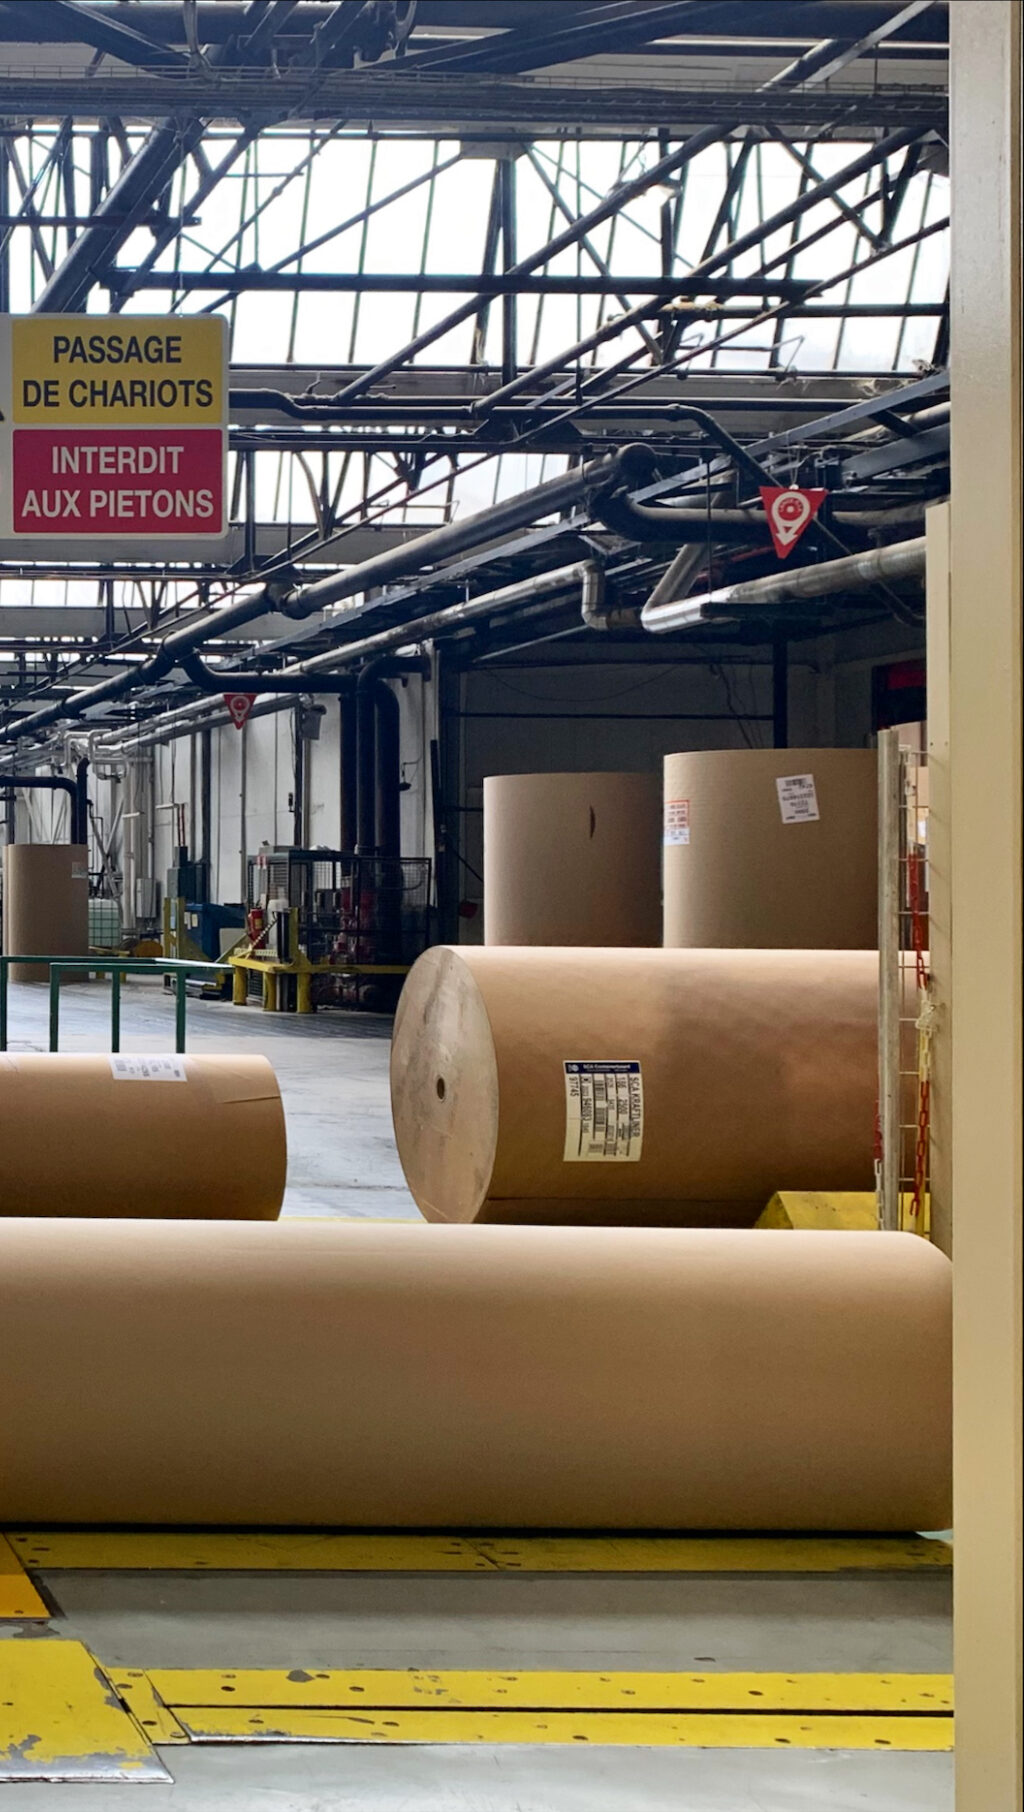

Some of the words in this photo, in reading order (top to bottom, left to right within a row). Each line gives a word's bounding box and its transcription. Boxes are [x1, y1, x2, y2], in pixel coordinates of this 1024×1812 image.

[53, 335, 183, 364] PASSAGE
[23, 379, 61, 408] DE
[68, 379, 214, 408] CHARIOTS
[52, 446, 185, 475] INTERDIT
[21, 489, 82, 518] AUX
[89, 489, 215, 518] PIETONS
[630, 1077, 640, 1093] SCA
[630, 1093, 641, 1138] KRAFTLINER
